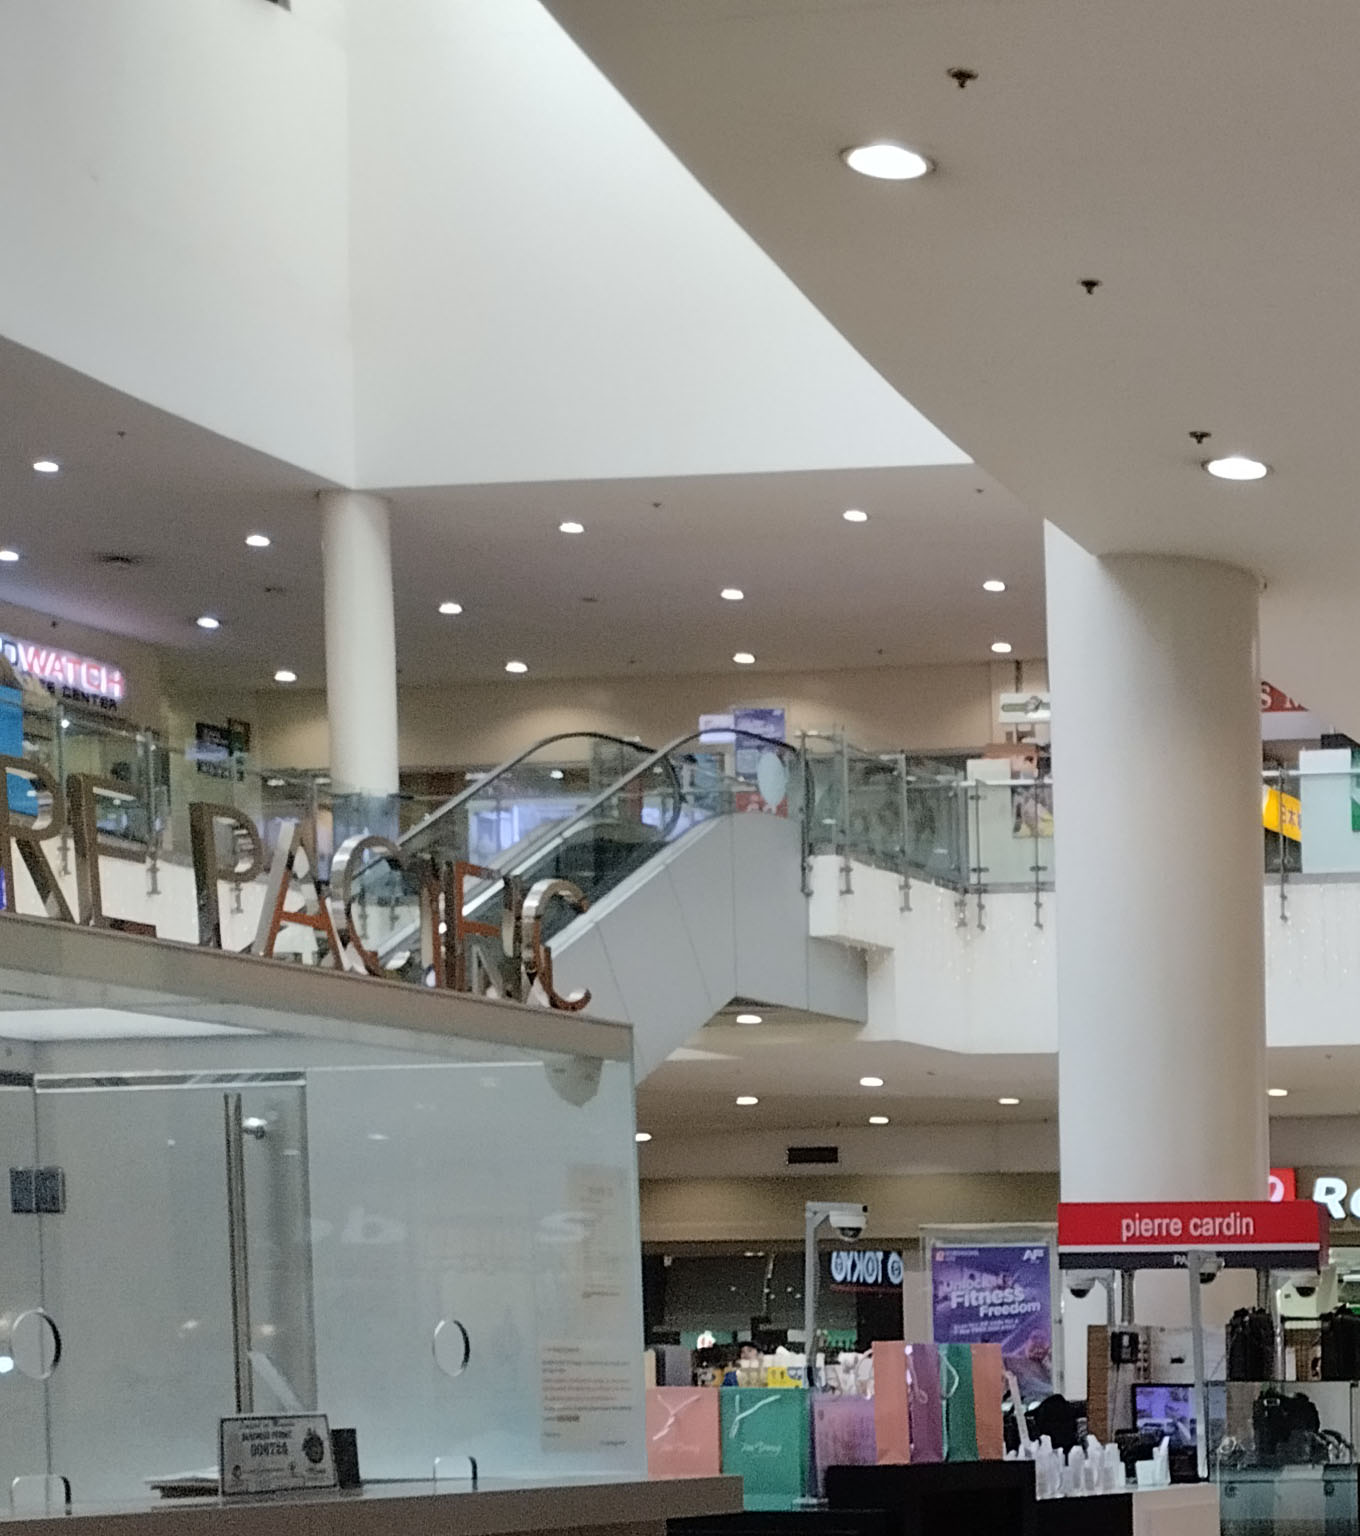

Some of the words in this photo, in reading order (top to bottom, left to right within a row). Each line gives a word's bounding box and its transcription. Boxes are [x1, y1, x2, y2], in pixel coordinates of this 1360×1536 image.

[1121, 1212, 1182, 1242] pierre
[1189, 1211, 1254, 1236] cardin
[951, 1283, 1025, 1309] Fitness
[979, 1301, 1041, 1317] Freedom
